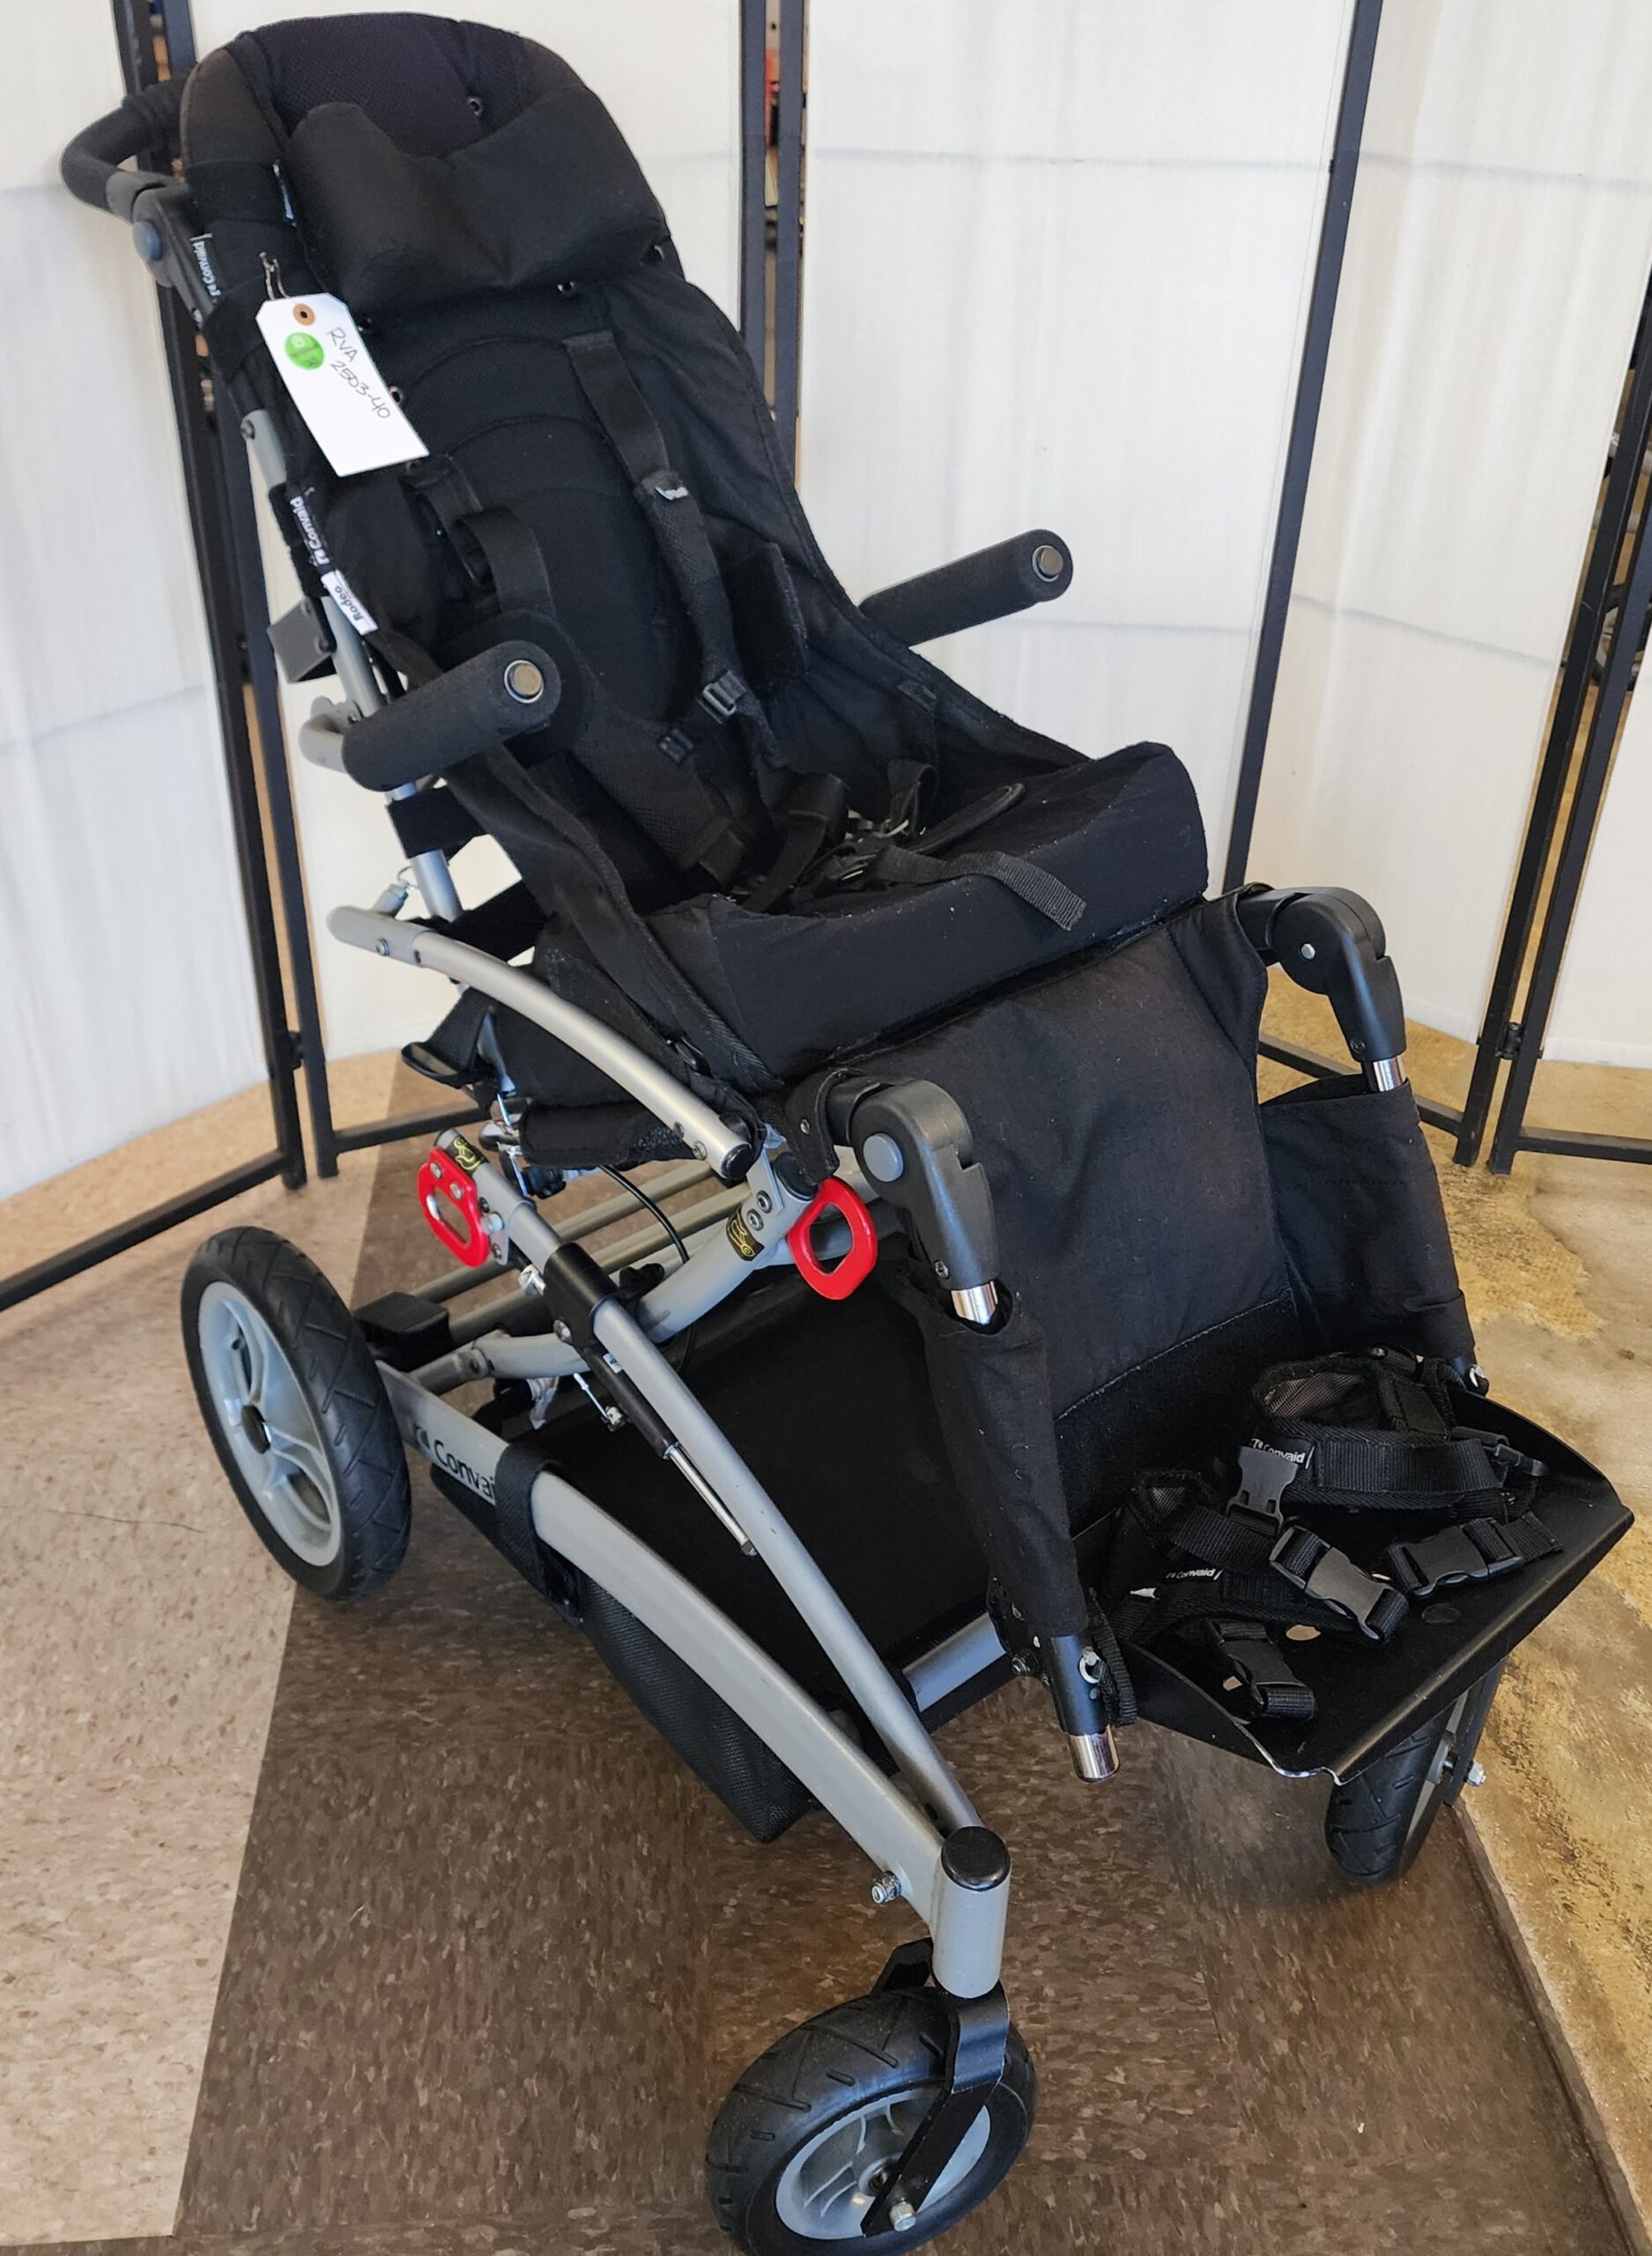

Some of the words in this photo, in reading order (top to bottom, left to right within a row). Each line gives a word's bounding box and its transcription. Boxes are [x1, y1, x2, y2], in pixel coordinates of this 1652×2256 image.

[326, 327, 358, 362] RVA
[330, 361, 390, 418] 2503-40
[290, 495, 322, 550] Convaid
[335, 585, 363, 621] Rodeo
[434, 1439, 496, 1498] Convai
[1176, 1569, 1216, 1578] Convaid
